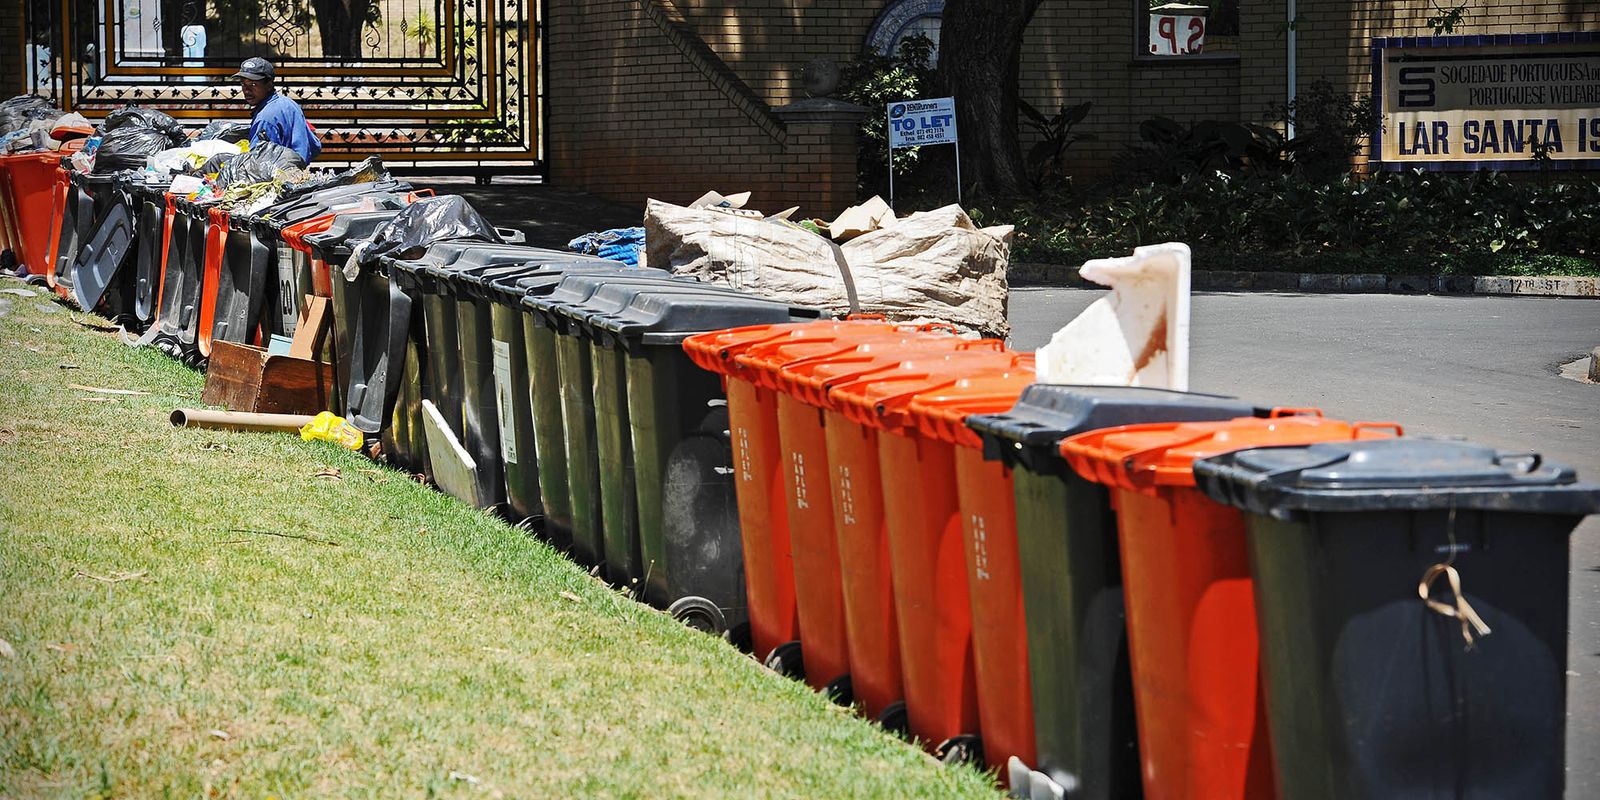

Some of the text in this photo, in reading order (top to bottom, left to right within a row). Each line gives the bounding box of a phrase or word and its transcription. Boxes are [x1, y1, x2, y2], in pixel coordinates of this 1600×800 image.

[1440, 64, 1506, 85] SOCIEDADE
[1510, 63, 1590, 83] PORTUGUESA
[1469, 86, 1546, 106] PORTUGUESE
[891, 114, 952, 131] TO LET
[1399, 121, 1449, 155] LAR
[1463, 119, 1563, 154] SANTA
[1545, 280, 1560, 291] ST
